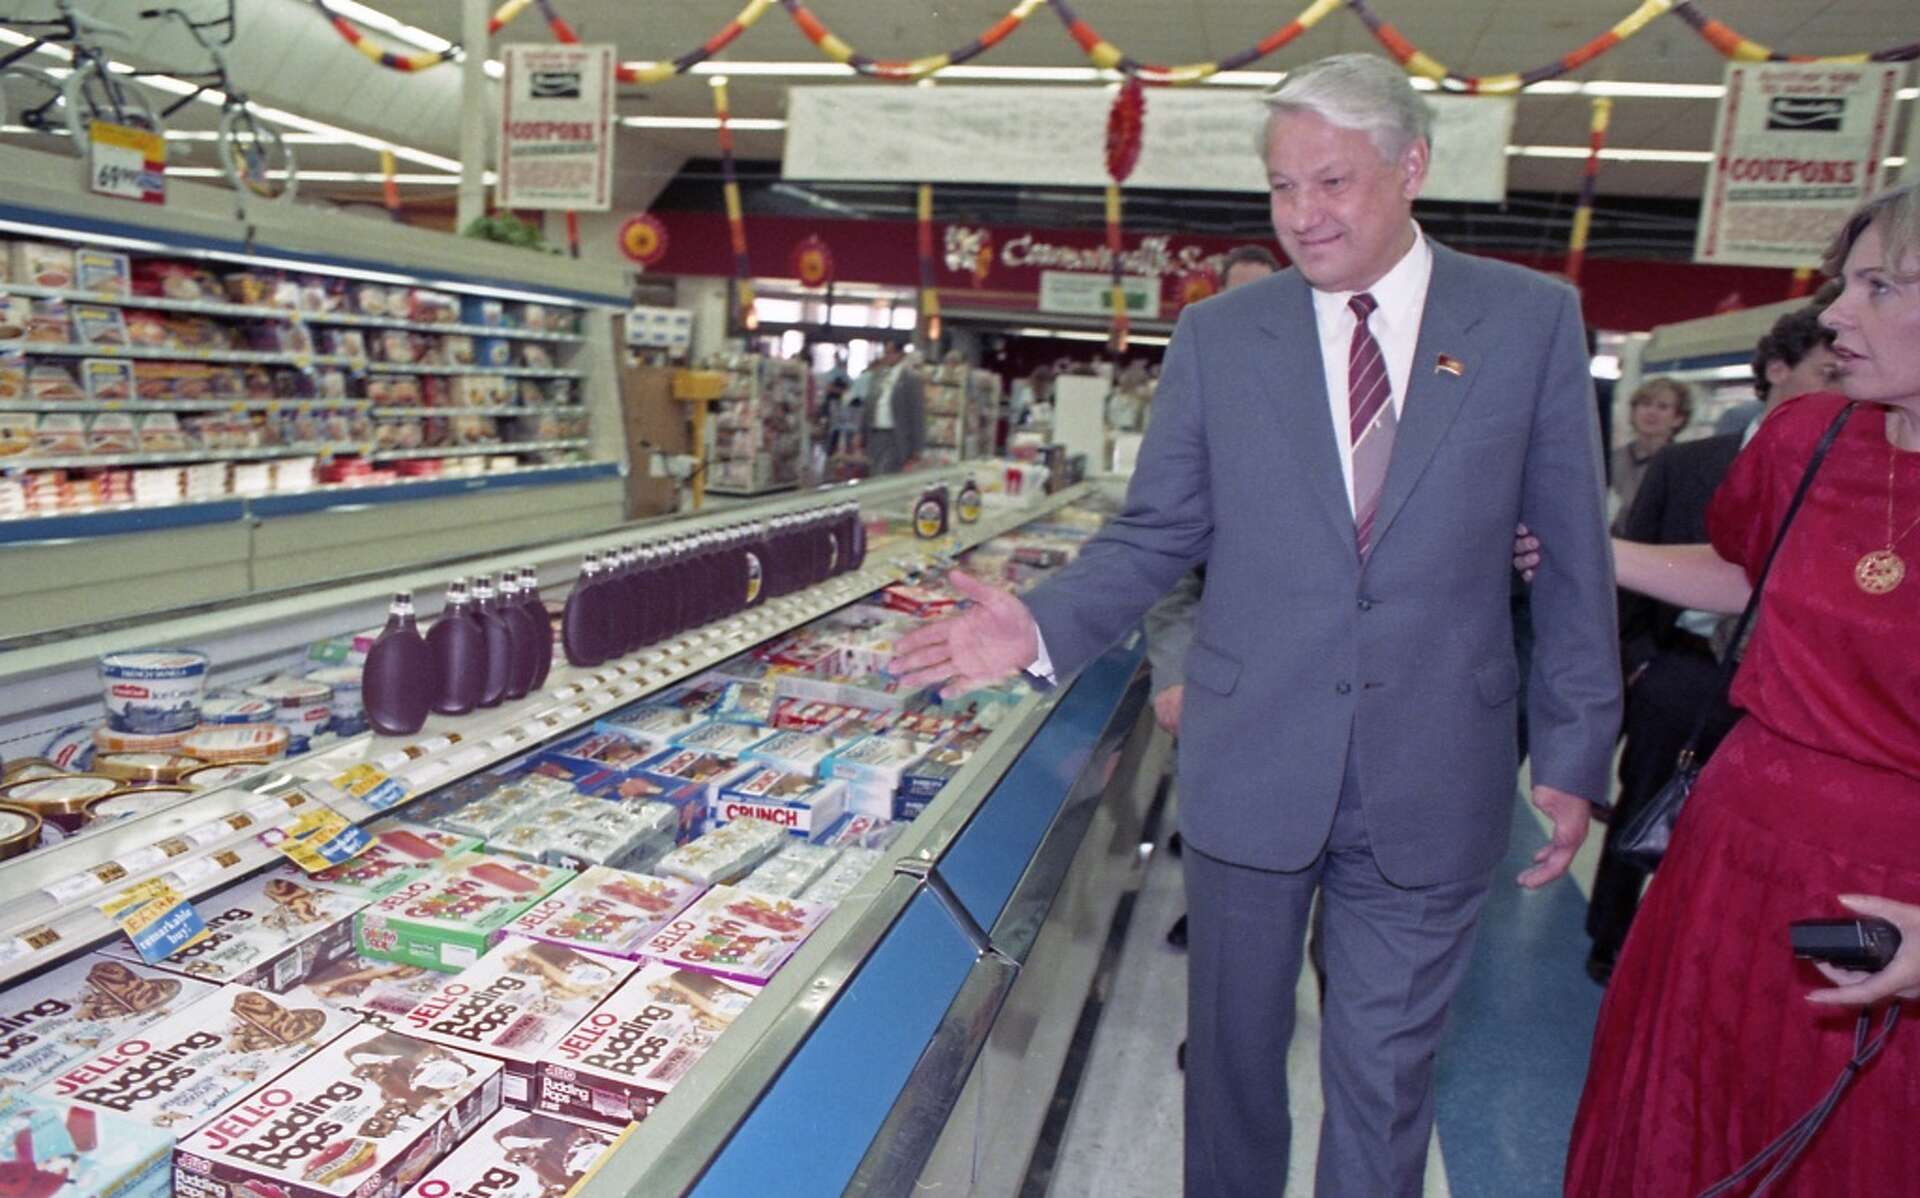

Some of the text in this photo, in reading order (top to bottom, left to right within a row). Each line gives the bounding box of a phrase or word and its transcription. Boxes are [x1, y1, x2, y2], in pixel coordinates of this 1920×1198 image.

[1729, 158, 1857, 183] COUPONS
[726, 803, 797, 826] CRUNCH
[125, 895, 178, 931] EXTRA
[139, 908, 193, 950] remarkable
[429, 976, 526, 1036] Pudding
[456, 1004, 517, 1042] Pops
[582, 1005, 673, 1069] Pudding
[609, 1036, 668, 1076] Pops
[74, 1031, 222, 1104] Pudding
[100, 1066, 196, 1112] Pops
[543, 1077, 589, 1101] Pudding
[543, 1088, 570, 1104] Pops
[226, 1081, 363, 1162] Pudding
[257, 1121, 343, 1170] Pops
[175, 1168, 226, 1198] Pudding
